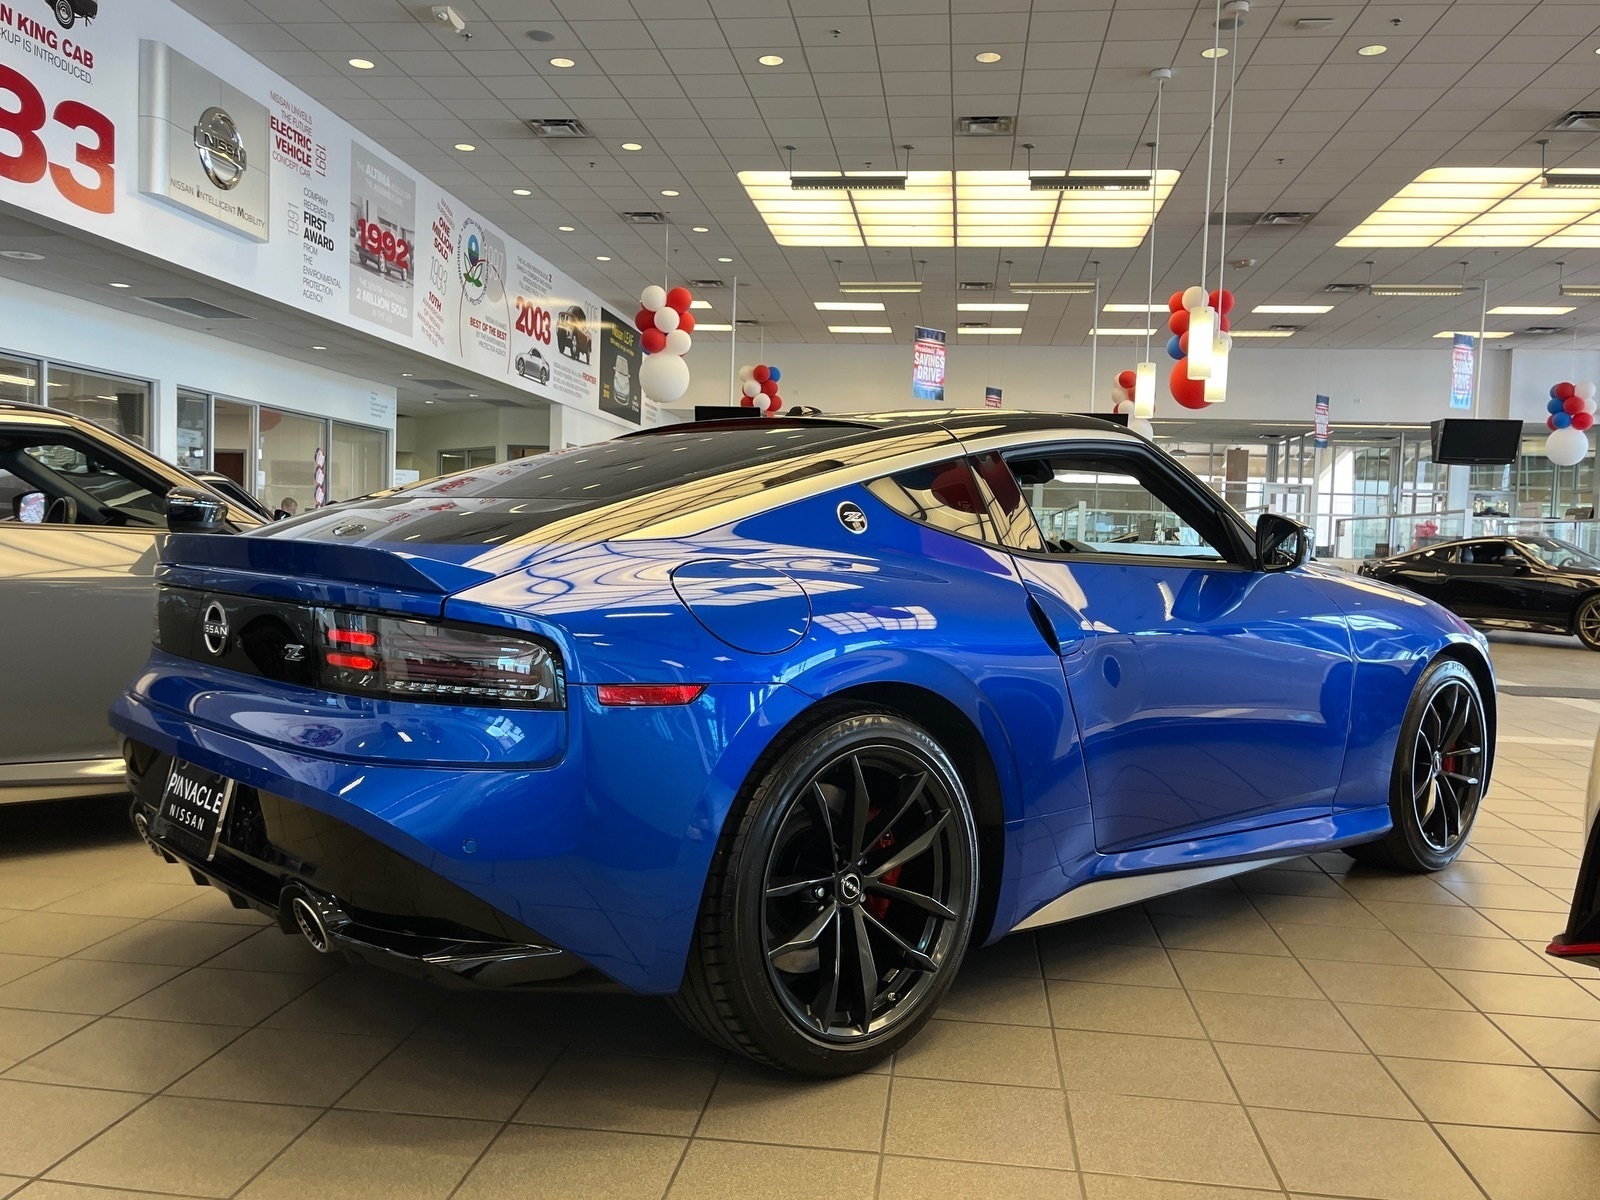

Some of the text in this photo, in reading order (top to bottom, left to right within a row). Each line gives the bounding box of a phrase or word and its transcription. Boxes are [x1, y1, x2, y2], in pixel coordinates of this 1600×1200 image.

[0, 28, 20, 45] KUP
[23, 39, 31, 53] IS
[18, 13, 57, 50] KING
[62, 39, 93, 69] CAB
[270, 115, 312, 151] ELECTRIC
[281, 110, 313, 137] THE FUTURE
[0, 64, 115, 214] 83
[275, 135, 312, 168] VEHICLE
[272, 150, 299, 172] CONCEPT
[315, 143, 327, 177] 1991
[170, 178, 194, 195] NISSAN
[365, 163, 391, 189] ALTIMA
[303, 187, 329, 207] COMPANY
[303, 210, 327, 233] FIRST
[438, 216, 451, 238] ONE
[303, 227, 334, 252] AWARD
[303, 242, 318, 256] FROM
[357, 218, 408, 269] 1992
[432, 221, 454, 255] MILLION
[303, 254, 313, 265] THE
[303, 277, 333, 296] PROTECTION
[356, 288, 408, 318] 2 MILLION SOLD
[428, 291, 442, 312] 10TH
[470, 316, 481, 330] BEST
[482, 322, 488, 331] OF
[496, 329, 507, 341] BEST
[515, 295, 551, 345] 2003
[914, 352, 945, 368] SAVINGS
[917, 365, 941, 382] DRIVE
[284, 643, 304, 662] Z
[169, 803, 205, 831] NISSAN
